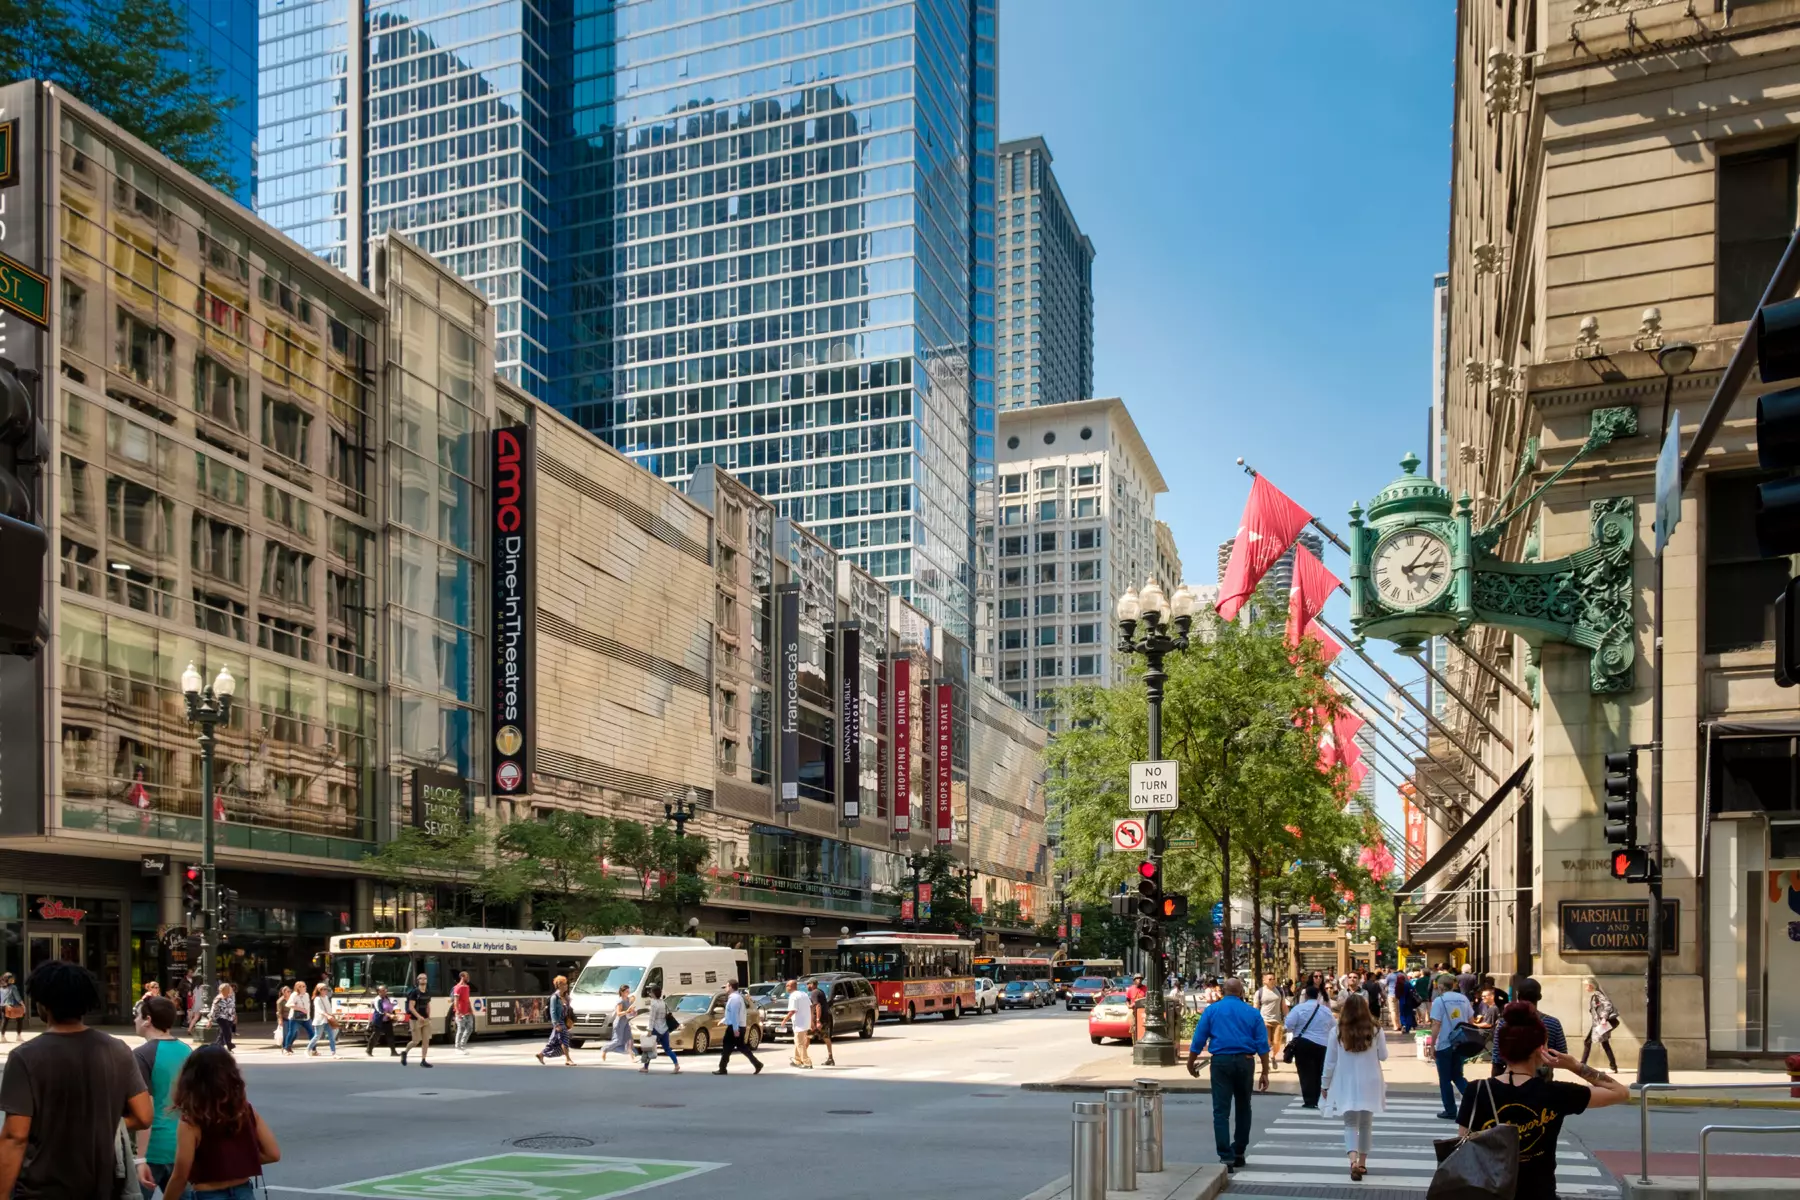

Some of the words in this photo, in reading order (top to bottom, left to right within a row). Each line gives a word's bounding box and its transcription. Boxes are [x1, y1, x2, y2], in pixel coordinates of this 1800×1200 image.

[497, 431, 520, 532] amc
[782, 642, 797, 733] francesca's
[898, 690, 906, 725] DINING
[940, 703, 948, 731] STATE
[940, 734, 948, 742] N
[940, 745, 948, 763] 108
[898, 746, 906, 797] SHOPPING
[940, 767, 948, 778] AT
[1145, 767, 1162, 777] NO
[1140, 780, 1168, 790] TURN
[940, 782, 948, 811] SHOPS
[1134, 794, 1149, 804] ON
[1153, 793, 1173, 803] RED
[424, 820, 458, 837] SEVEN
[143, 859, 164, 870] Disney
[36, 897, 86, 926] Disney
[1570, 909, 1631, 923] MARSHALL
[1607, 923, 1630, 931] AND
[451, 941, 470, 949] Clean
[472, 941, 482, 950] Air
[483, 942, 505, 951] Hybrid
[505, 943, 518, 951] Bus
[1590, 933, 1648, 948] COMPANY
